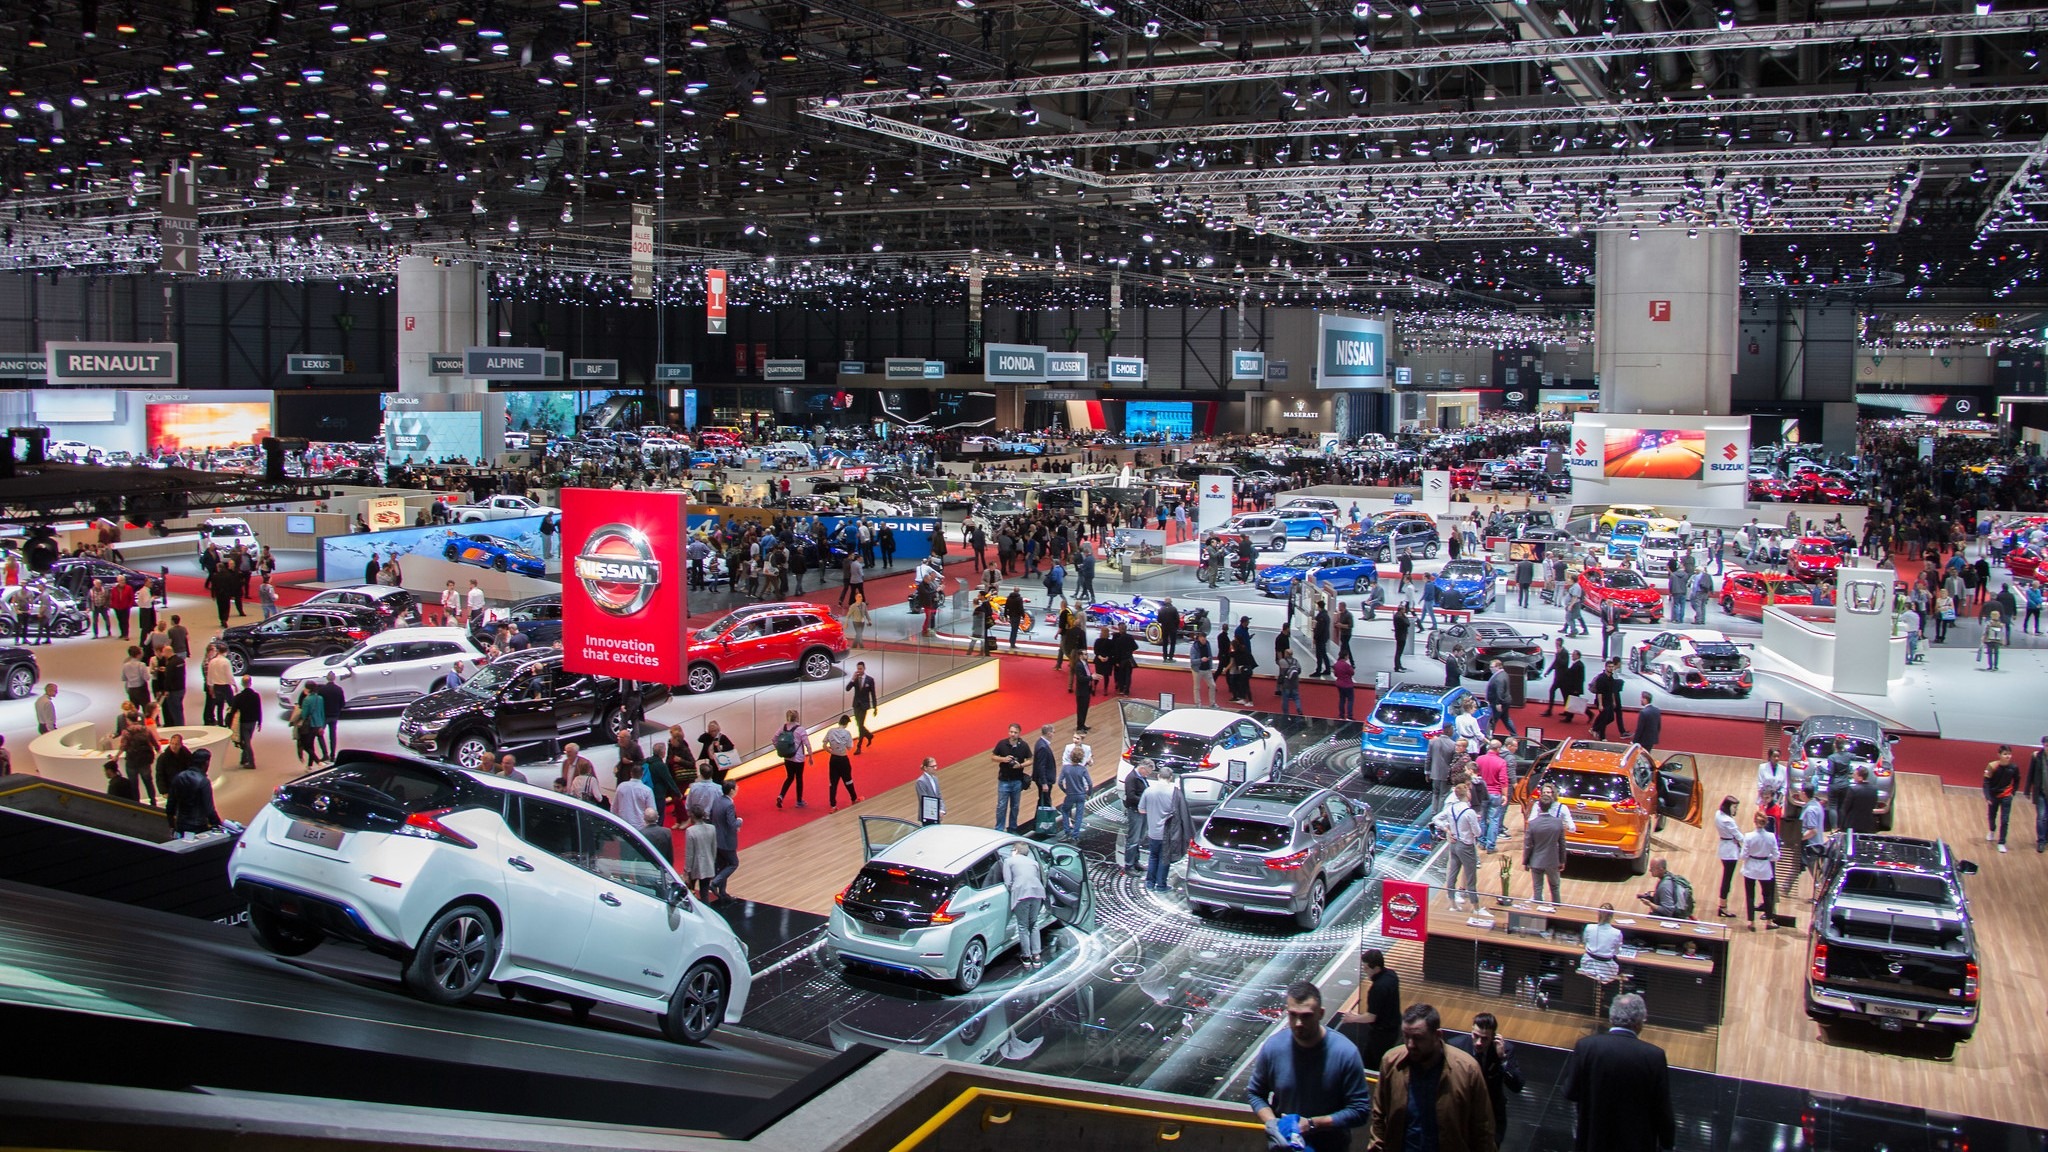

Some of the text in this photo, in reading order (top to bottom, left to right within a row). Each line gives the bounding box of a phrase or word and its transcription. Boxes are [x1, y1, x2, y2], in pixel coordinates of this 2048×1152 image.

[633, 207, 652, 216] HALLE
[164, 219, 196, 230] HALLE
[639, 216, 645, 226] 4
[175, 231, 185, 245] 3
[632, 241, 653, 253] 4200
[1655, 302, 1667, 317] F
[1336, 340, 1373, 366] NISSAN
[69, 355, 160, 372] RENAULT
[302, 360, 331, 369] LEXUS
[487, 358, 524, 368] ALPINE
[1000, 356, 1036, 371] HONDA
[1052, 361, 1080, 372] KLASSEN
[587, 365, 602, 374] RUF
[668, 368, 681, 377] JEEP
[1116, 364, 1137, 375] E-MOKE
[376, 500, 399, 508] ISUZU
[874, 522, 934, 532] LPINE
[579, 559, 647, 580] NISSAN
[585, 634, 655, 653] Innovation
[582, 647, 660, 667] that excites
[303, 829, 326, 839] LEAF
[1874, 1005, 1910, 1016] NISSAN
